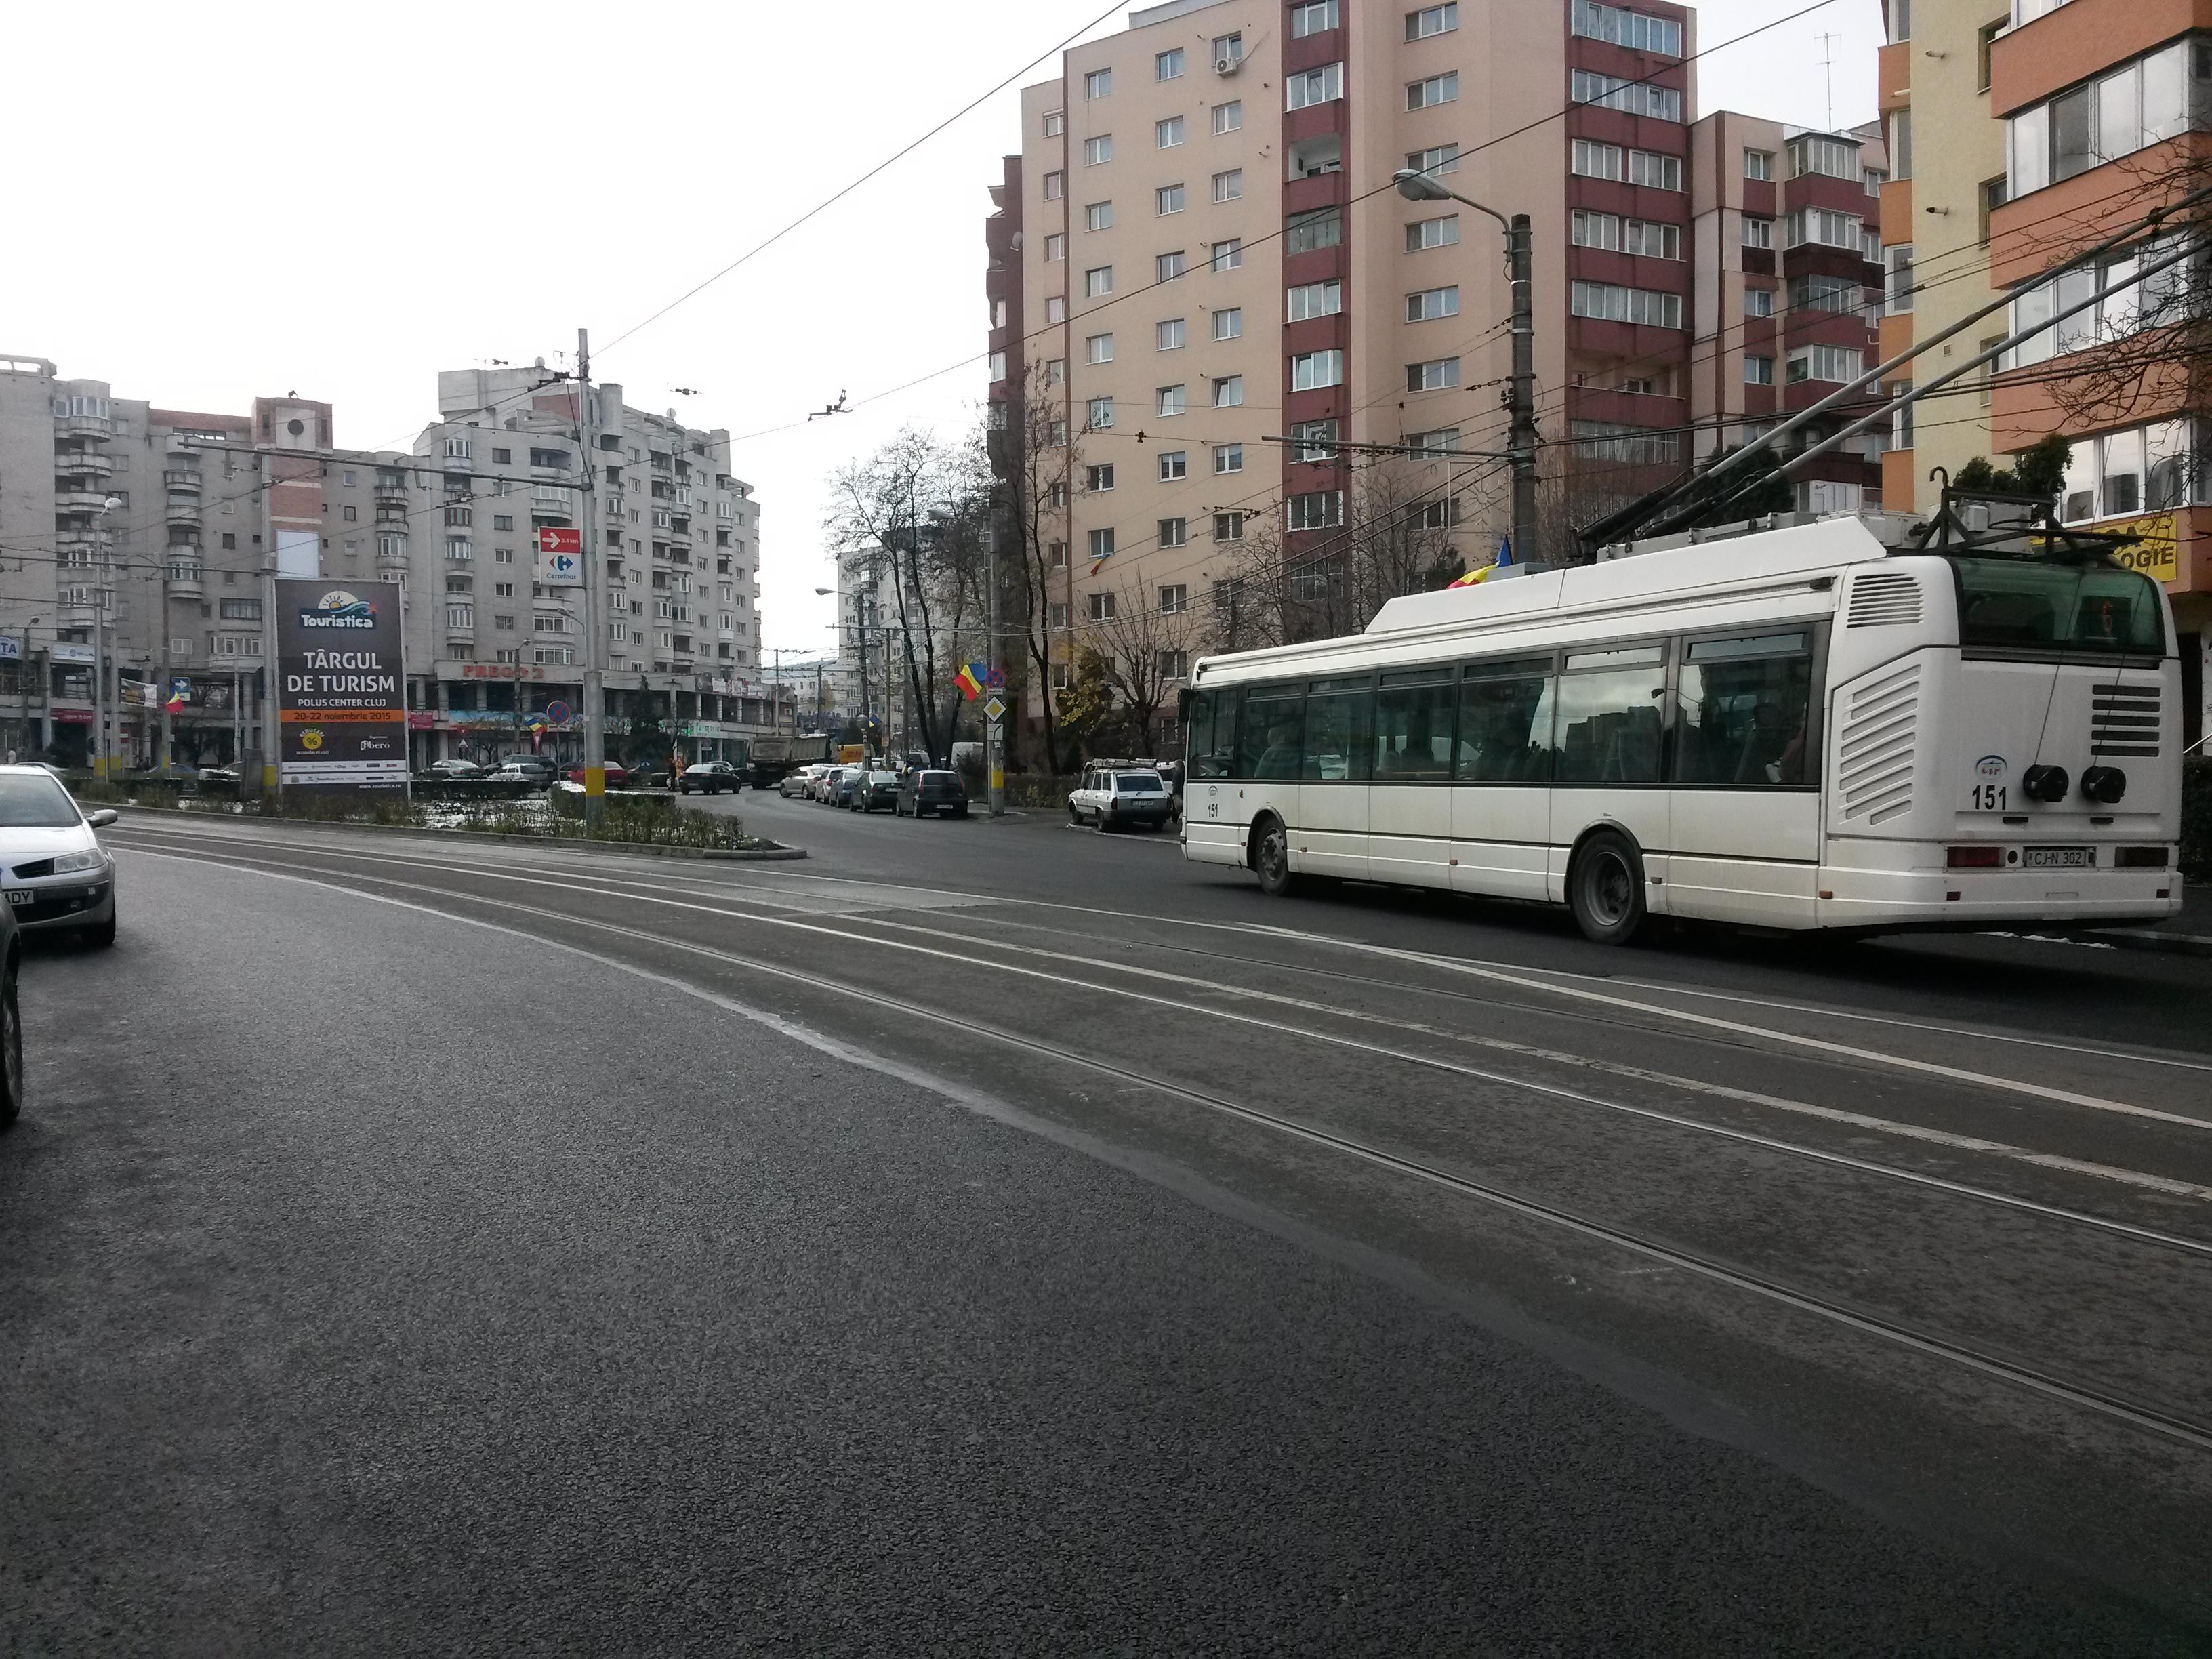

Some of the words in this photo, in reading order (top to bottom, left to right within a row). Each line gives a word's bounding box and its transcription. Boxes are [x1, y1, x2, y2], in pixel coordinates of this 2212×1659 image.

[2121, 546, 2175, 569] OGIE
[300, 614, 373, 628] Touristica
[303, 649, 382, 670] TÂRGUL
[287, 675, 314, 692] DE
[319, 675, 395, 693] TURISM
[298, 699, 327, 707] POLUS
[329, 699, 363, 707] CENTER
[364, 699, 386, 707] CLUJ
[324, 712, 368, 720] noiembrie
[1972, 785, 2007, 811] 151
[1208, 803, 1218, 817] 151
[2034, 852, 2059, 865] CJ-N
[2063, 852, 2081, 865] 302
